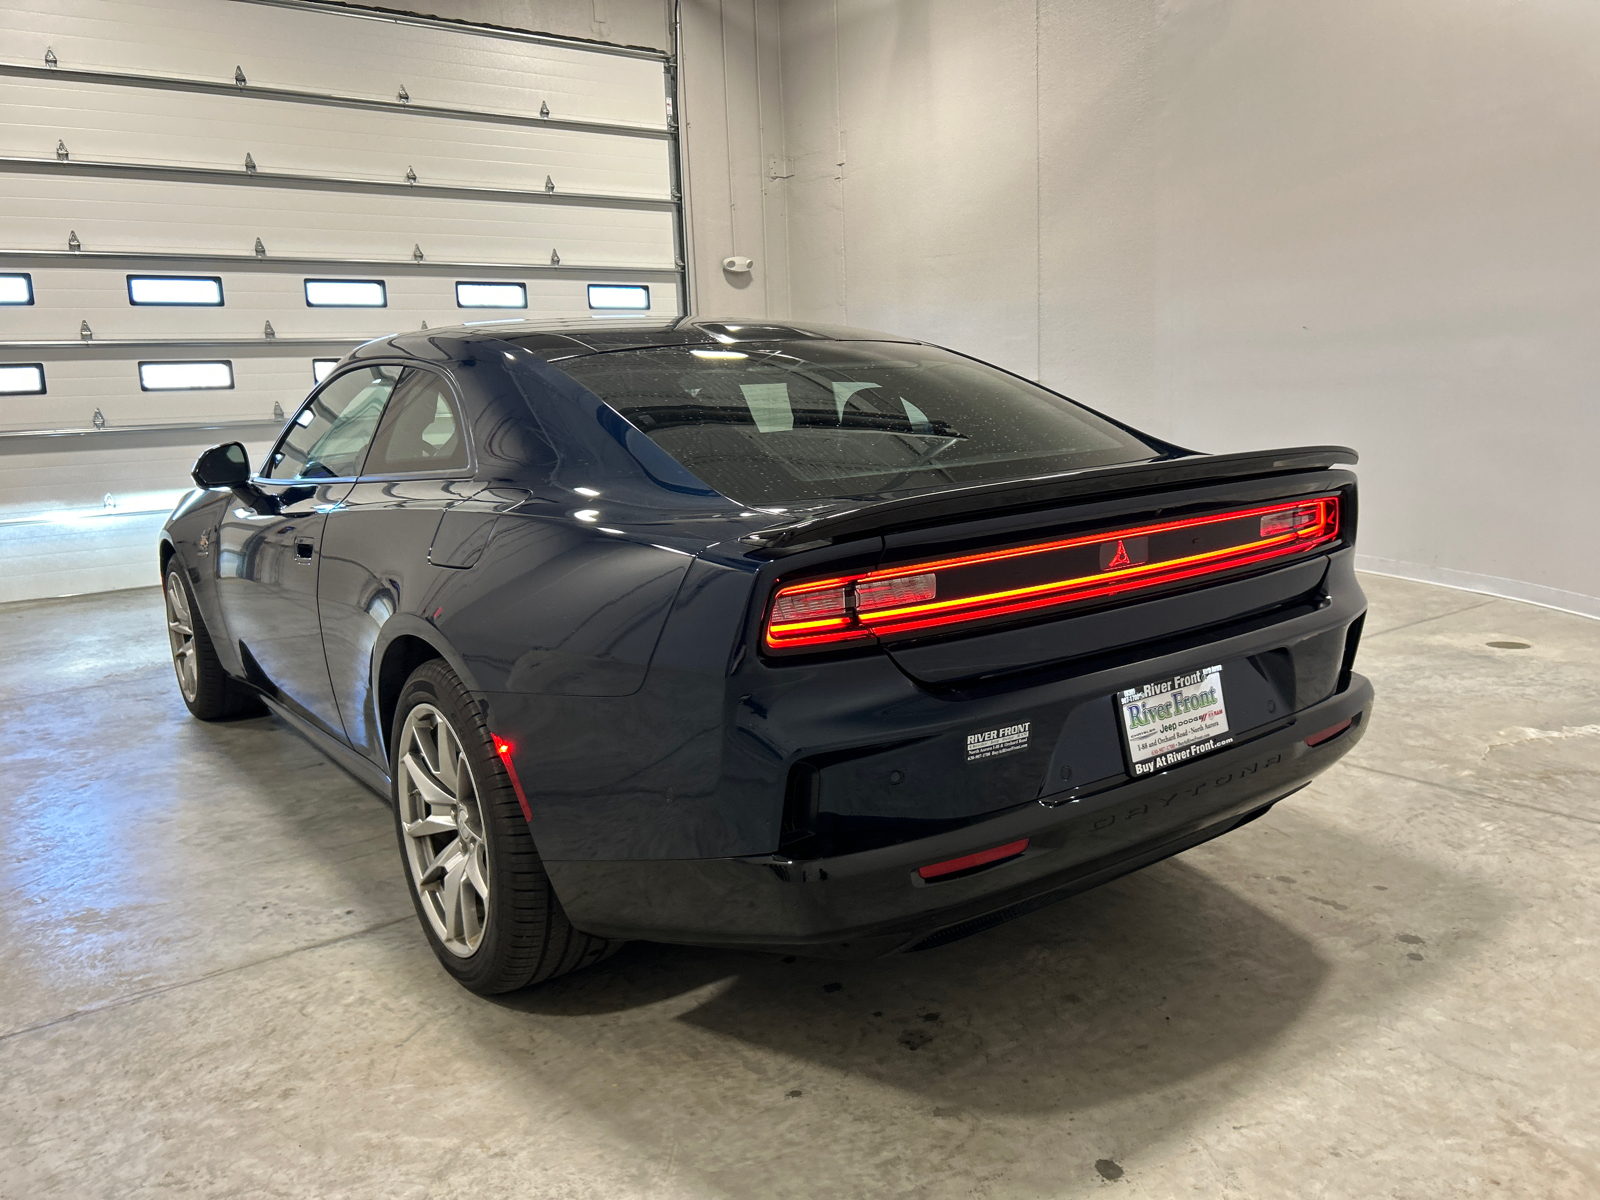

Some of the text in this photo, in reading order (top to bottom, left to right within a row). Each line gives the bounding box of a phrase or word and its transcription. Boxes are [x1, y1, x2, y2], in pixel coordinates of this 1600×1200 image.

[1143, 680, 1172, 697] River
[1174, 671, 1201, 688] Front
[1127, 686, 1218, 729] River Front
[967, 722, 1030, 744] RIVER FRONT
[1148, 738, 1158, 748] and
[1157, 732, 1176, 746] Orchard
[1176, 730, 1189, 740] Road
[1190, 725, 1204, 735] North
[1204, 720, 1219, 730] Aurora
[1160, 722, 1178, 733] Jeep
[1135, 762, 1156, 775] Buy
[1156, 756, 1167, 769] At
[1166, 749, 1191, 764] River
[1088, 753, 1282, 832] DAYTONA
